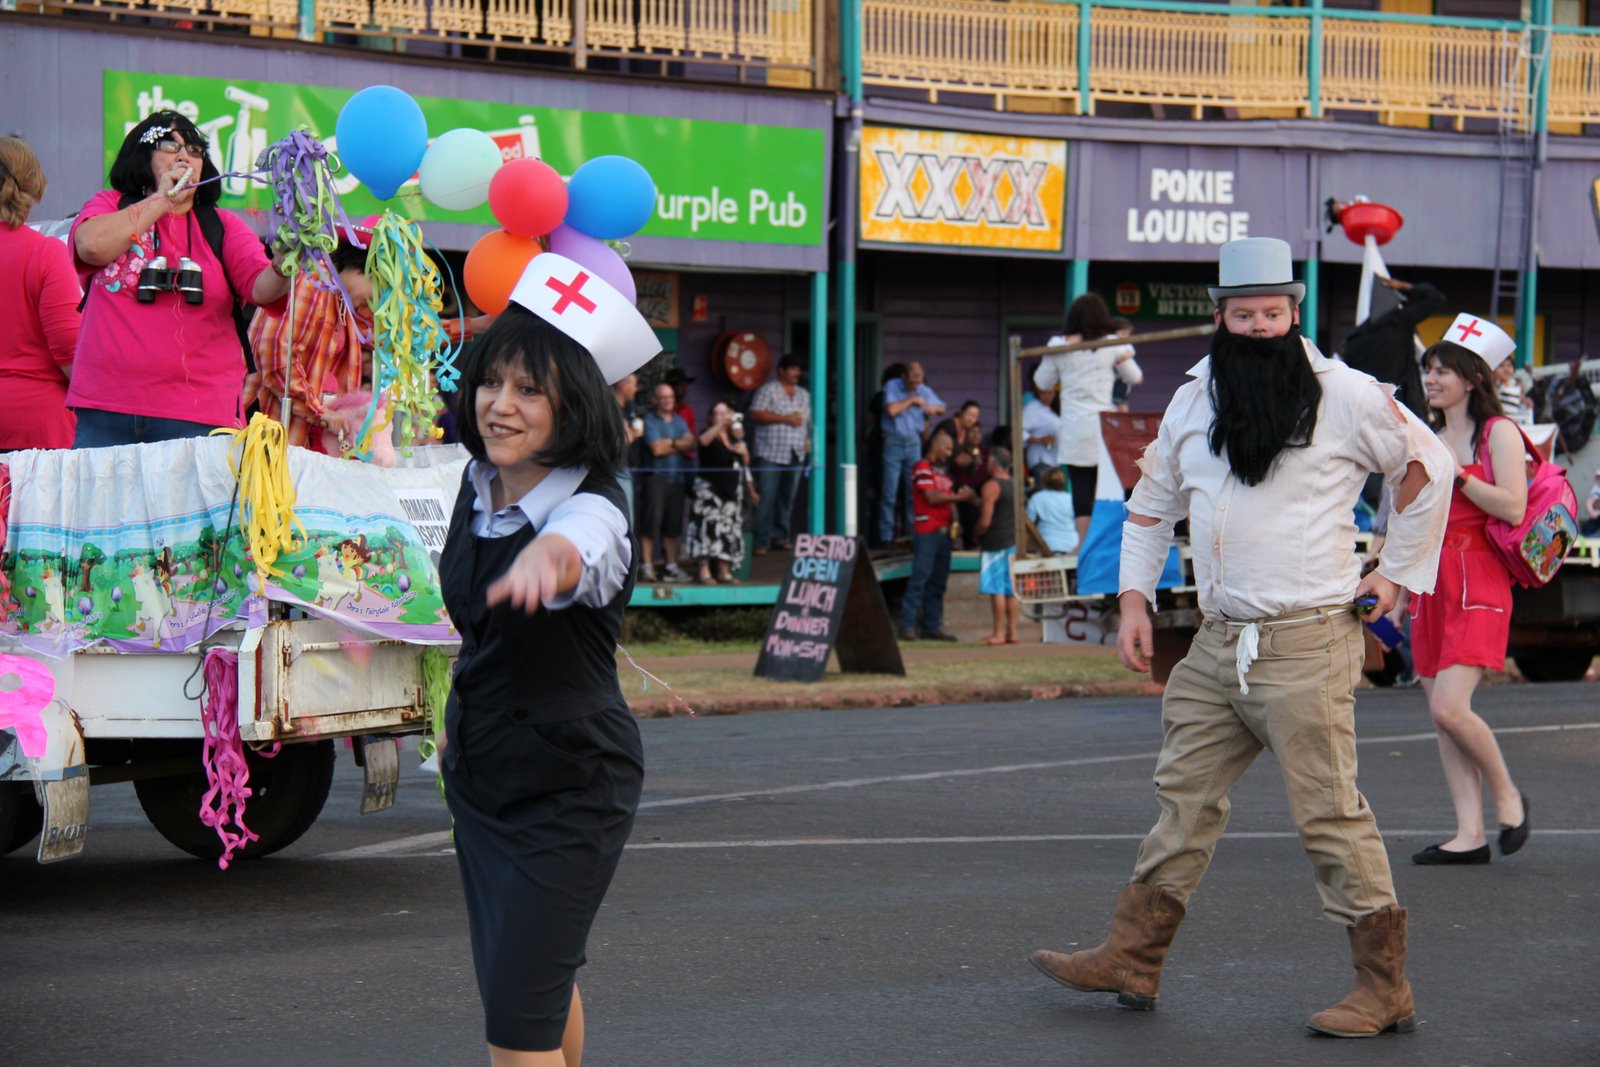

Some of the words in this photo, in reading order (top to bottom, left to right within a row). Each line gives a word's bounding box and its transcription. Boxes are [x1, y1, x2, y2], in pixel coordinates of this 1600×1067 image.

[137, 85, 199, 126] the
[873, 150, 1049, 226] XXXX
[1151, 167, 1235, 204] POKIE
[655, 186, 739, 232] urple
[748, 188, 808, 228] Pub
[1127, 207, 1250, 244] LOUNGE
[1148, 283, 1209, 299] VICTOR
[399, 499, 447, 521] ORMANTON
[412, 525, 449, 547] SPITA
[794, 534, 856, 562] BISTRO
[792, 557, 840, 582] OPEN
[786, 580, 837, 612] LUNCH
